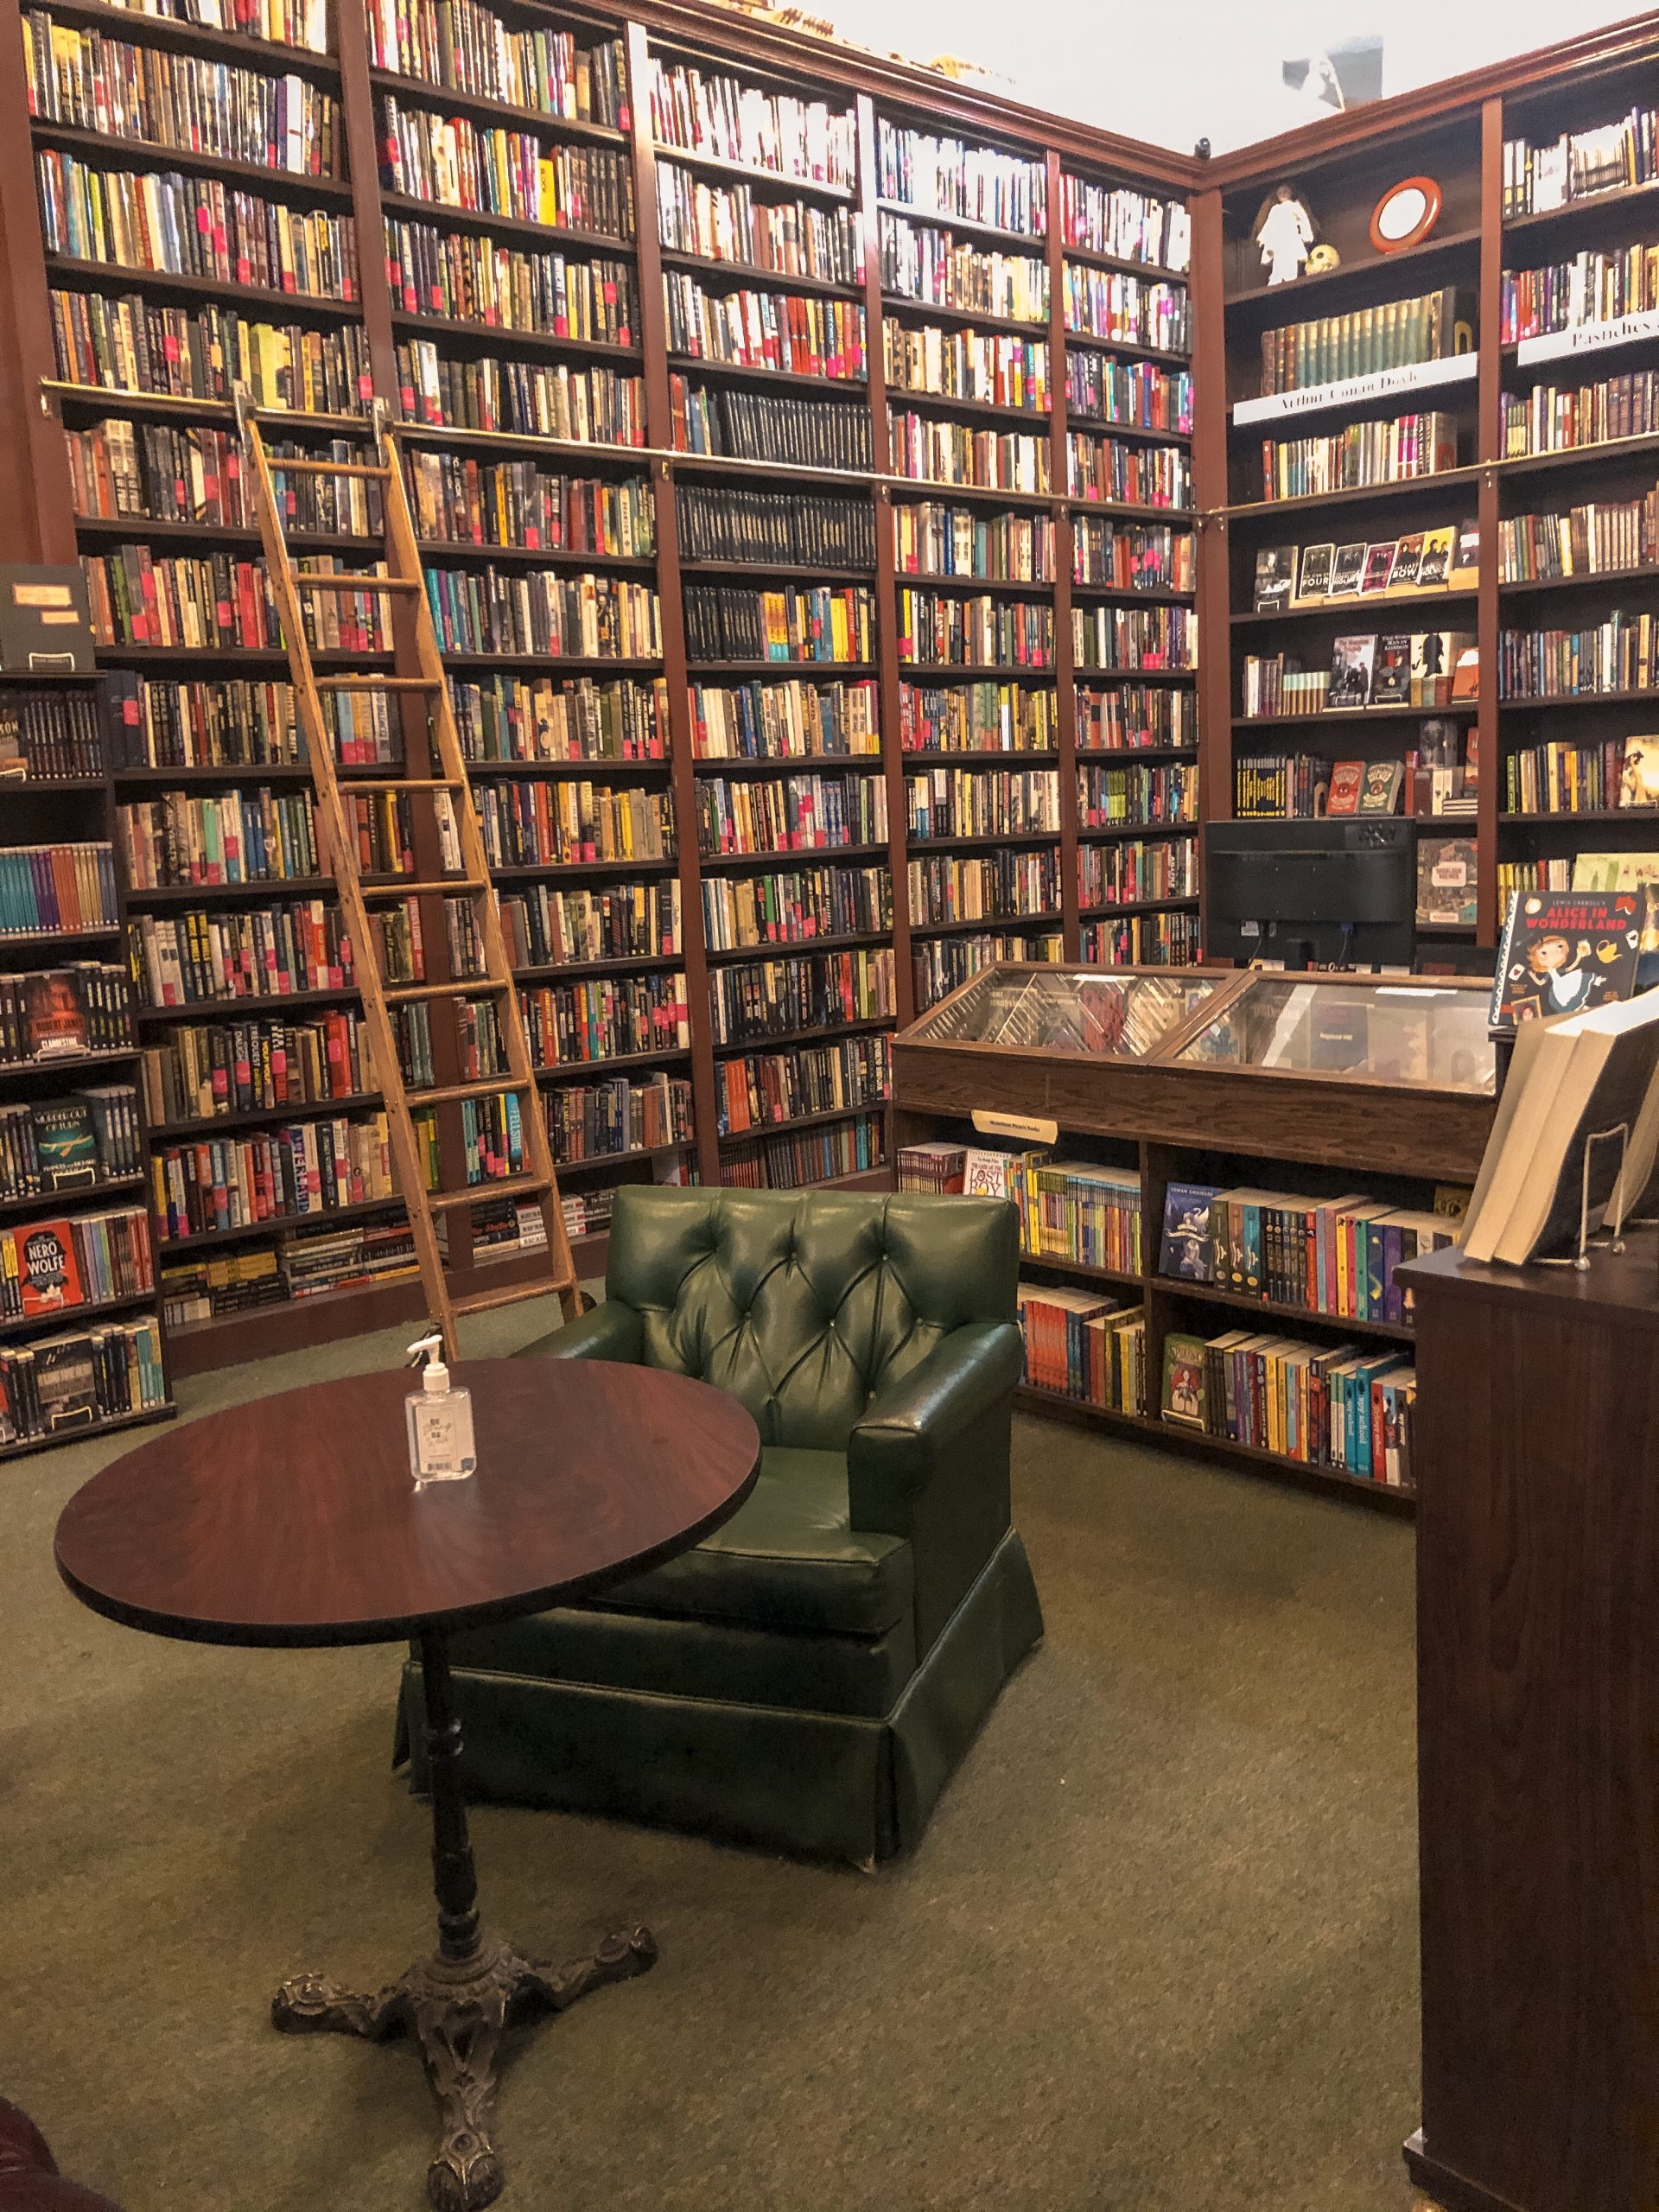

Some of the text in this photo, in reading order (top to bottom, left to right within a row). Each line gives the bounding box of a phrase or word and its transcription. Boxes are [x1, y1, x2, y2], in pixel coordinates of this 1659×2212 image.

[1573, 321, 1650, 347] Pastiches
[1280, 393, 1323, 409] Arthur
[1330, 383, 1375, 398] Conan
[1392, 568, 1417, 579] BOW
[1302, 575, 1329, 588] FOUR
[1547, 906, 1609, 918] ALICE IN
[1526, 918, 1628, 930] WONDERLAND
[35, 1109, 87, 1124] MURDER OUT
[509, 1109, 521, 1152] FELLSIDE
[969, 1168, 1002, 1183] LOST
[969, 1180, 1001, 1196] BOY
[28, 1242, 58, 1261] NERO
[27, 1255, 66, 1276] WOLFE
